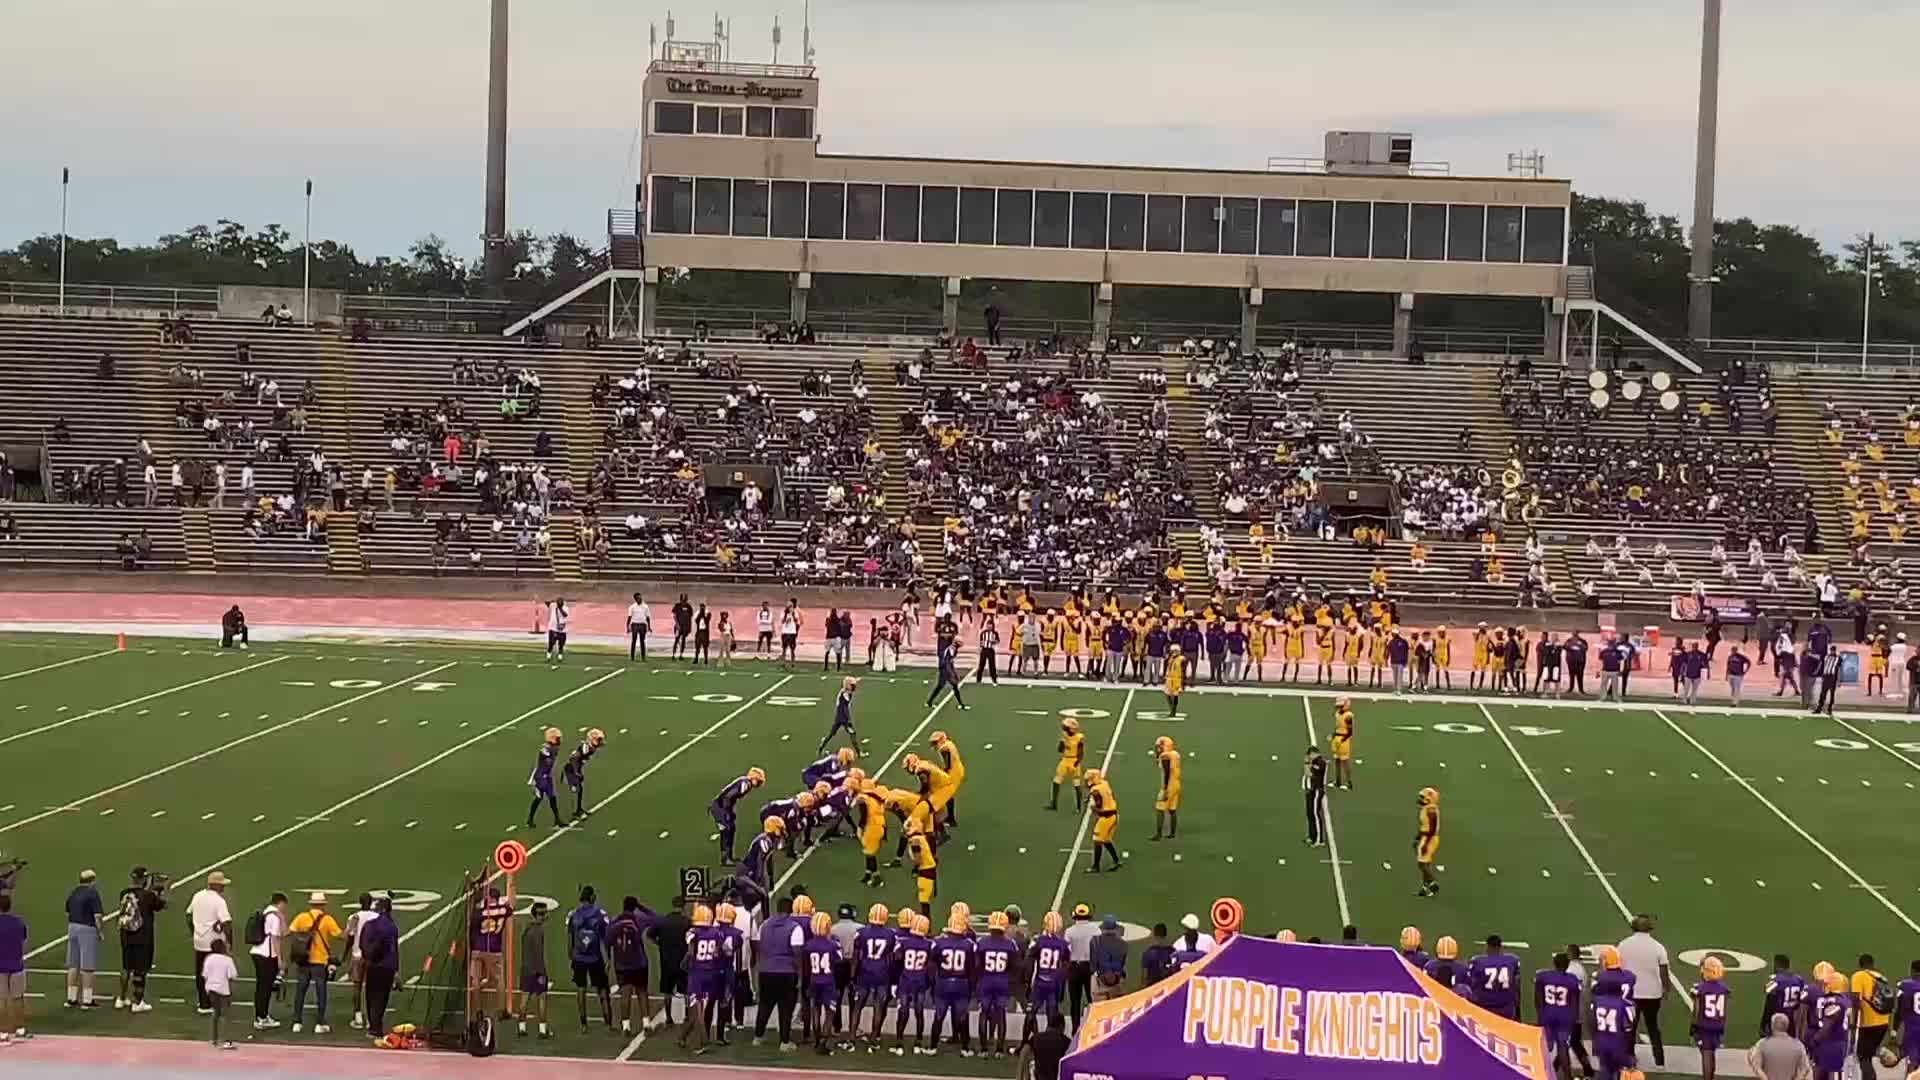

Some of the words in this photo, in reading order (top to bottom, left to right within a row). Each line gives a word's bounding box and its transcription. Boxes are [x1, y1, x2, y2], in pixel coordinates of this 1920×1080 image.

[666, 77, 692, 93] The
[685, 869, 703, 897] 2
[866, 939, 887, 960] 17
[904, 949, 928, 970] 82
[941, 949, 966, 971] 30
[1039, 948, 1060, 969] 81
[984, 951, 1008, 972] 56
[1484, 967, 1510, 990] 74
[1704, 994, 1725, 1017] 54
[1183, 976, 1302, 1055] PURPLE
[1304, 990, 1443, 1065] KNIGHTS
